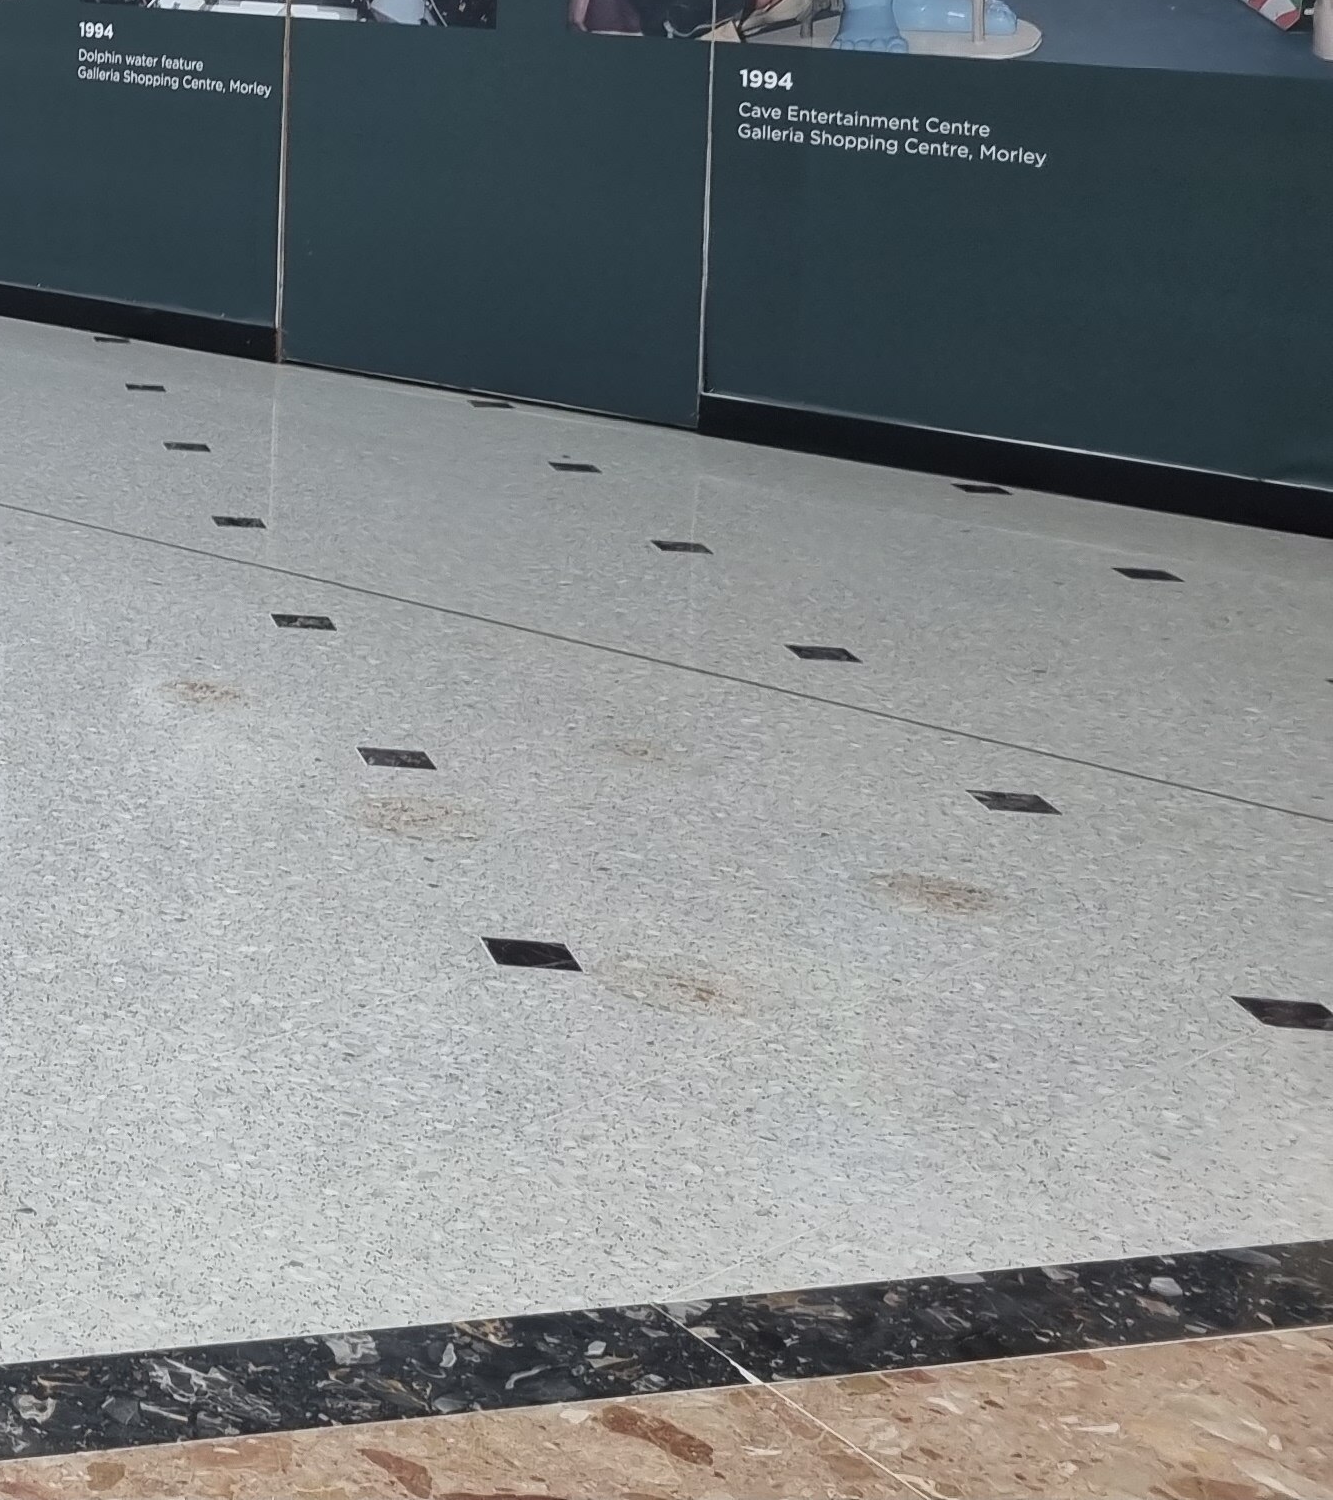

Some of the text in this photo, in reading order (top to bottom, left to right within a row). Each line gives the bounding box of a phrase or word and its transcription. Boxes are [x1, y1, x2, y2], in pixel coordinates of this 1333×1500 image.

[79, 22, 114, 39] 1994
[78, 49, 204, 71] Dolphin water feature
[77, 66, 273, 98] Galleria Shopping Centre, Morley
[739, 68, 794, 91] 1994
[738, 101, 991, 138] Cave Entertainment Centre
[737, 123, 1048, 168] Galleria Shopping Centre, Morley
